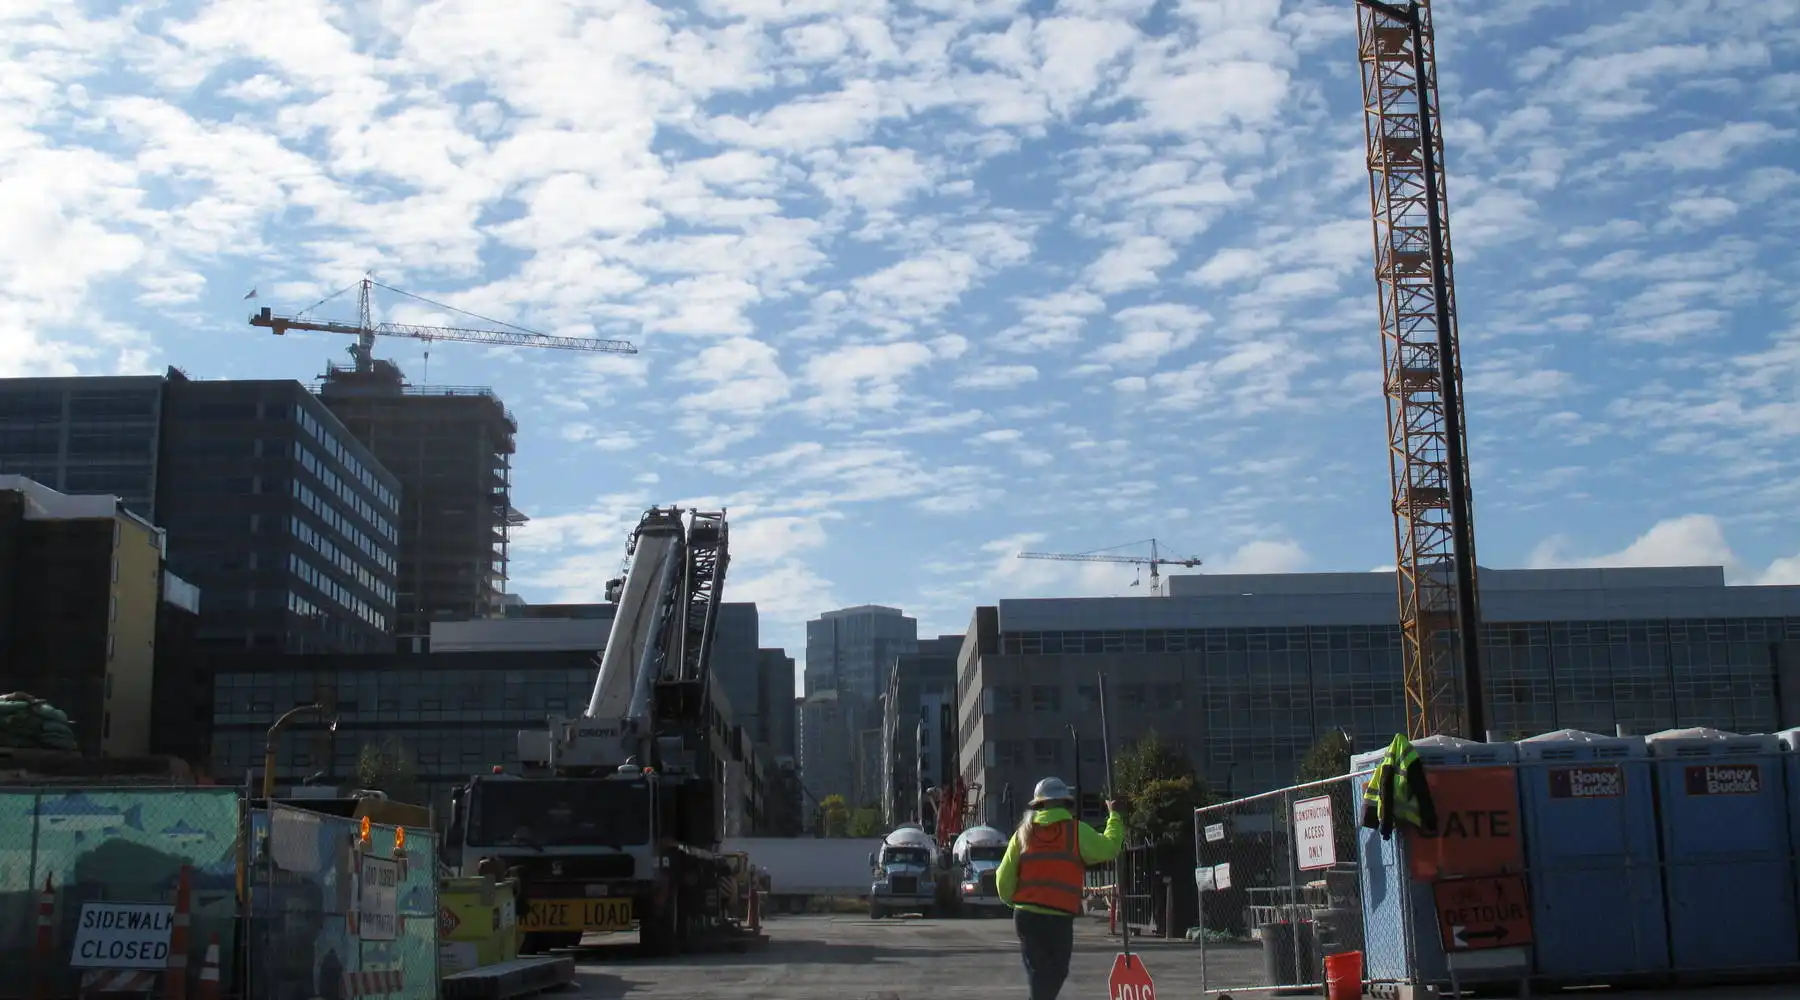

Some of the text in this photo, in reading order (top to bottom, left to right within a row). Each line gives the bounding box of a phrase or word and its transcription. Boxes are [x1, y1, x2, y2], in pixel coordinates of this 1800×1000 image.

[1570, 770, 1618, 784] Honey
[1706, 766, 1752, 782] Honey
[1572, 782, 1621, 796] Bucket
[1707, 779, 1758, 794] Bucket
[1296, 807, 1330, 822] CONSTRUCTION
[1416, 810, 1510, 838] ATE
[1304, 825, 1325, 840] ACCESS
[1308, 845, 1323, 859] ONLY
[584, 902, 630, 926] LOAD
[1445, 903, 1523, 926] DETOUR
[81, 940, 168, 960] CLOSED
